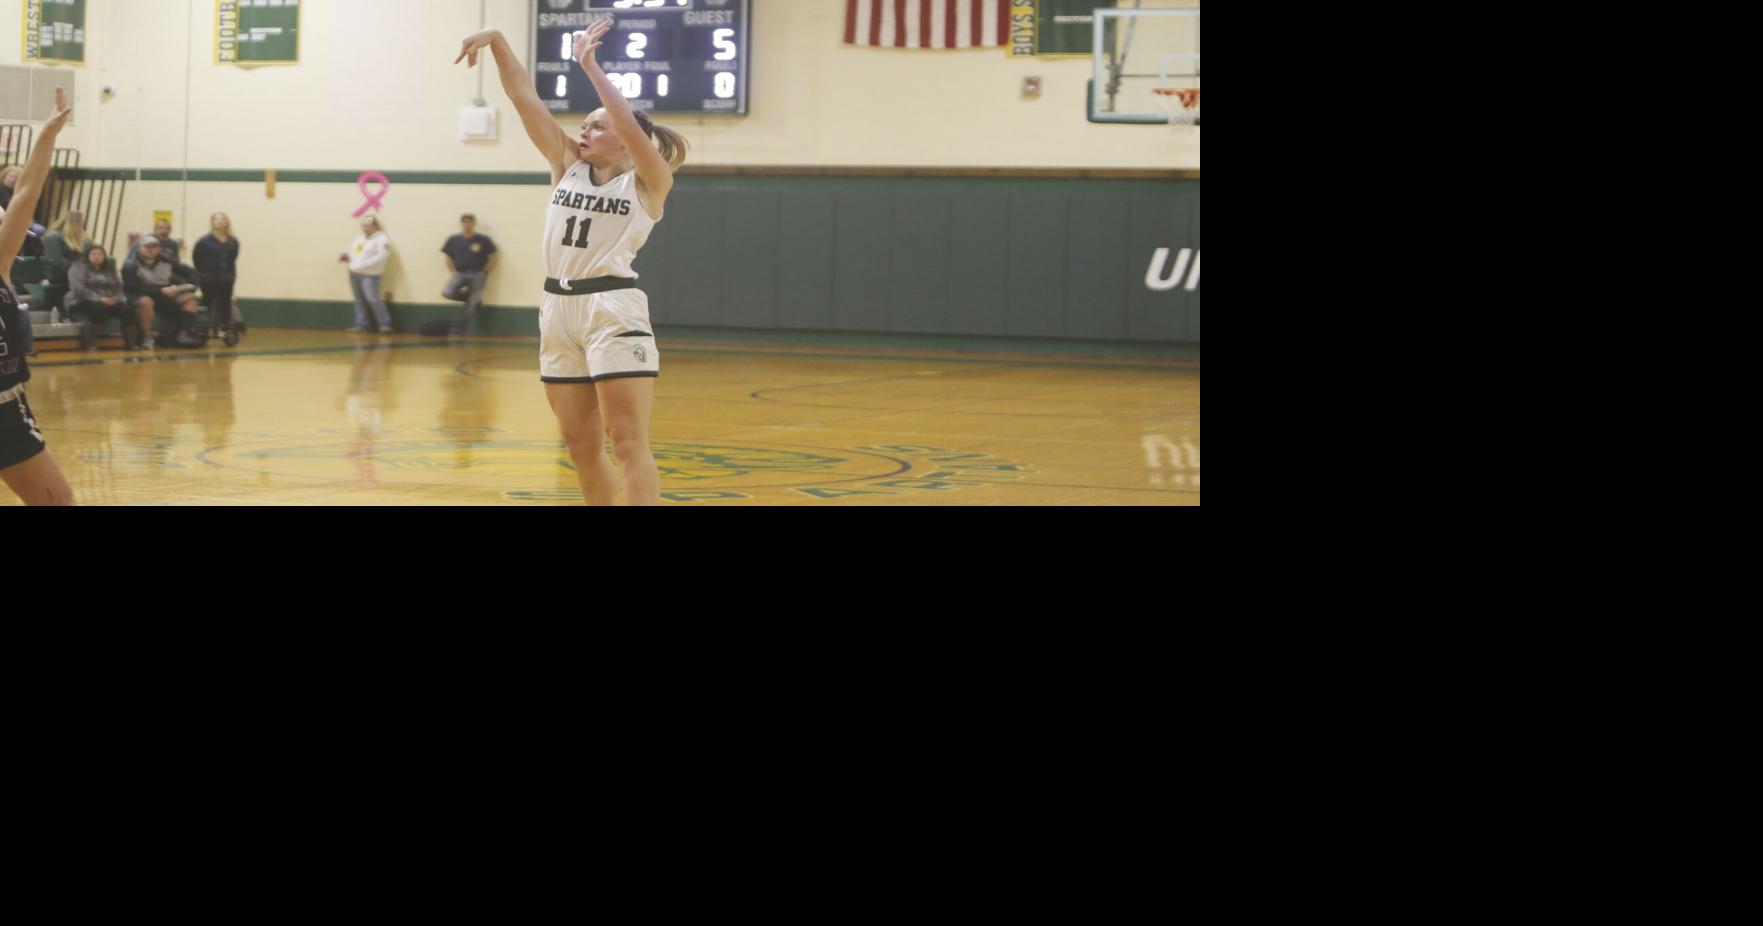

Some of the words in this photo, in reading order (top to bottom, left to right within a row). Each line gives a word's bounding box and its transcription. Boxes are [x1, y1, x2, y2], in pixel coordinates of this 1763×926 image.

[218, 0, 235, 62] FOOTB
[684, 10, 734, 25] GUEST
[626, 32, 647, 58] 2
[713, 28, 736, 60] 5
[1013, 14, 1034, 56] BOYS
[556, 74, 566, 97] 1
[657, 74, 668, 97] 1
[714, 72, 735, 98] 0
[552, 188, 631, 216] SPARTANS
[561, 215, 592, 249] 11
